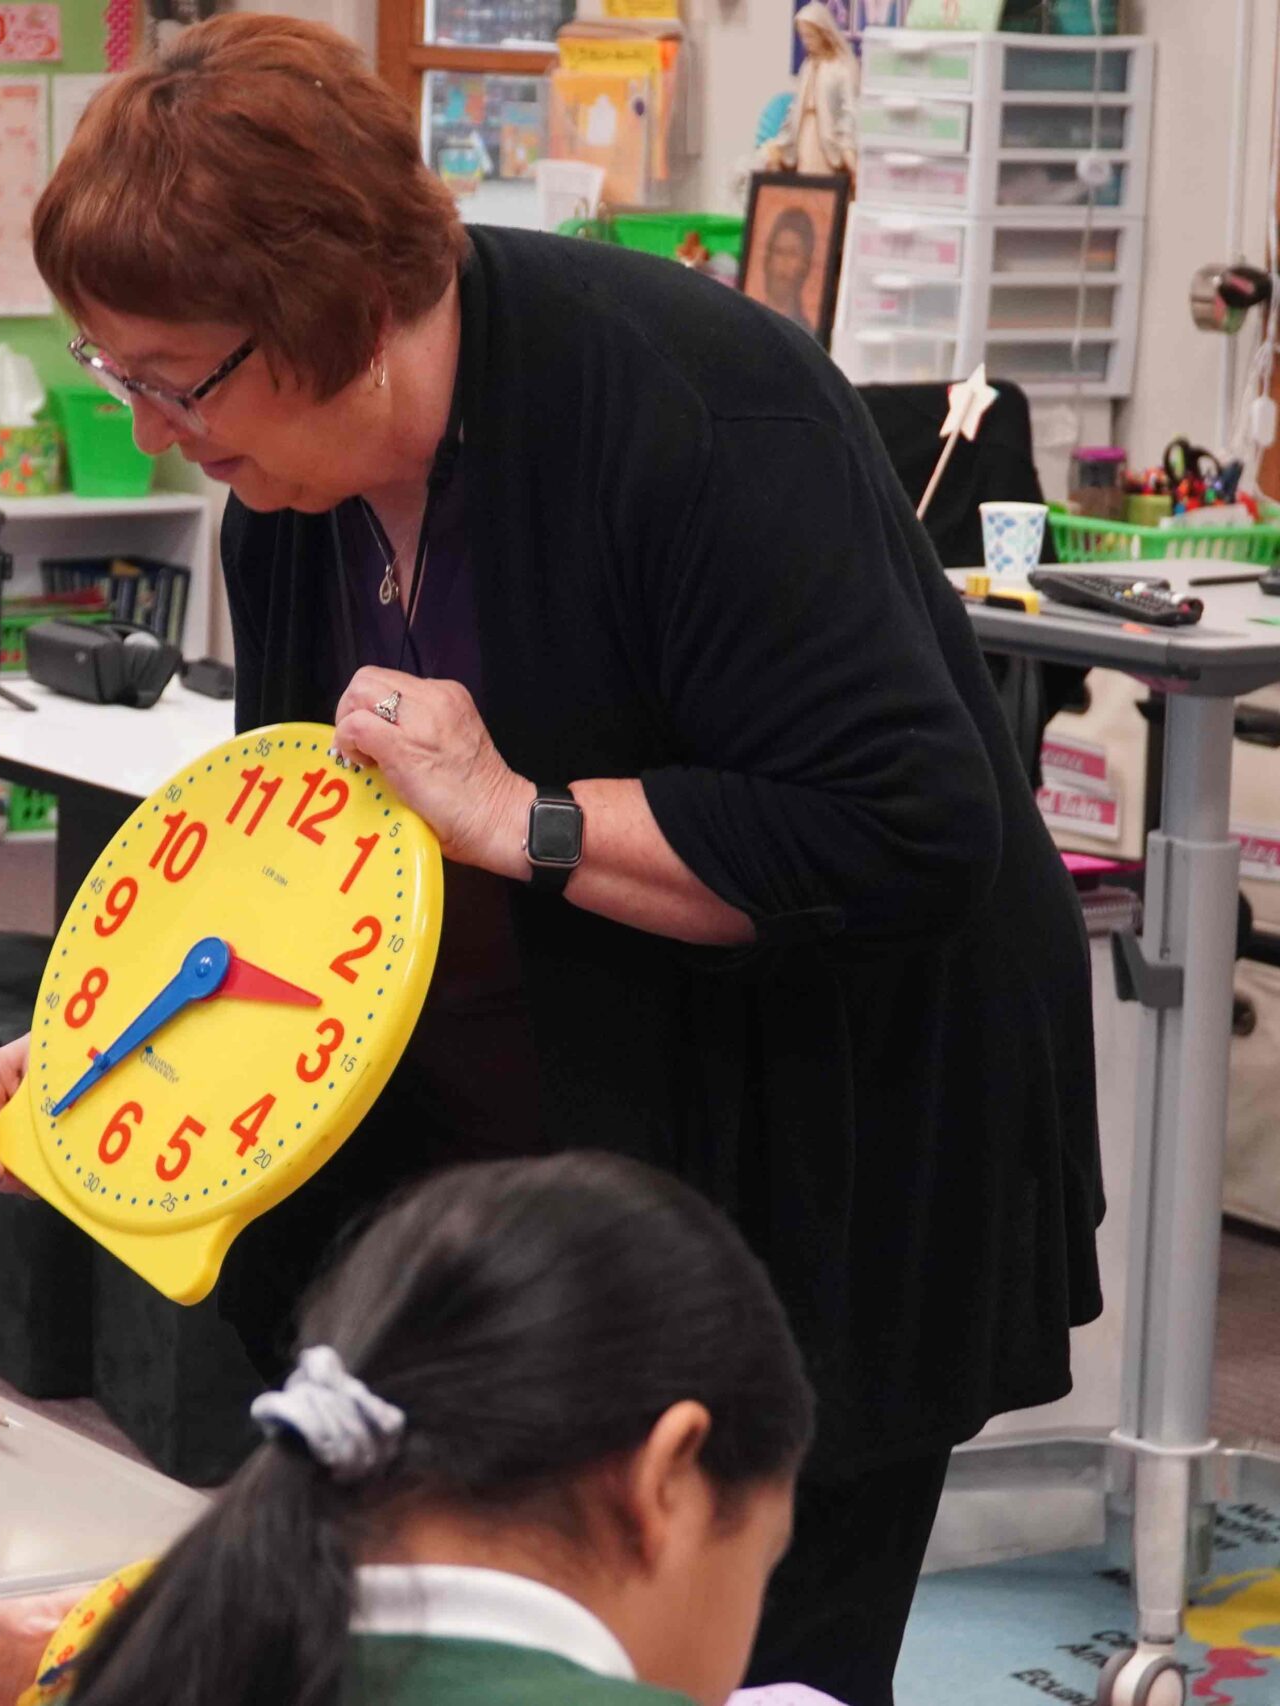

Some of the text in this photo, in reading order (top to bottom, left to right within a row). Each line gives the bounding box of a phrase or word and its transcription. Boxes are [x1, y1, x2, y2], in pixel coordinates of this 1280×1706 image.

[254, 738, 271, 757] 55
[165, 784, 182, 803] 50
[225, 765, 284, 837] 11
[287, 767, 350, 846] 12
[148, 810, 208, 884] 10
[389, 822, 402, 838] 5
[89, 876, 105, 894] 45
[339, 832, 380, 894] 1
[94, 876, 139, 938] 9
[329, 915, 383, 984] 2
[387, 934, 405, 953] 10
[44, 992, 60, 1010] 40
[64, 967, 109, 1029] 8
[296, 1017, 345, 1083] 3
[339, 1052, 358, 1073] 15
[98, 1101, 144, 1165] 6
[155, 1115, 206, 1182] 5
[229, 1093, 277, 1157] 4
[82, 1172, 101, 1193] 30
[253, 1148, 272, 1170] 20
[160, 1191, 179, 1213] 25
